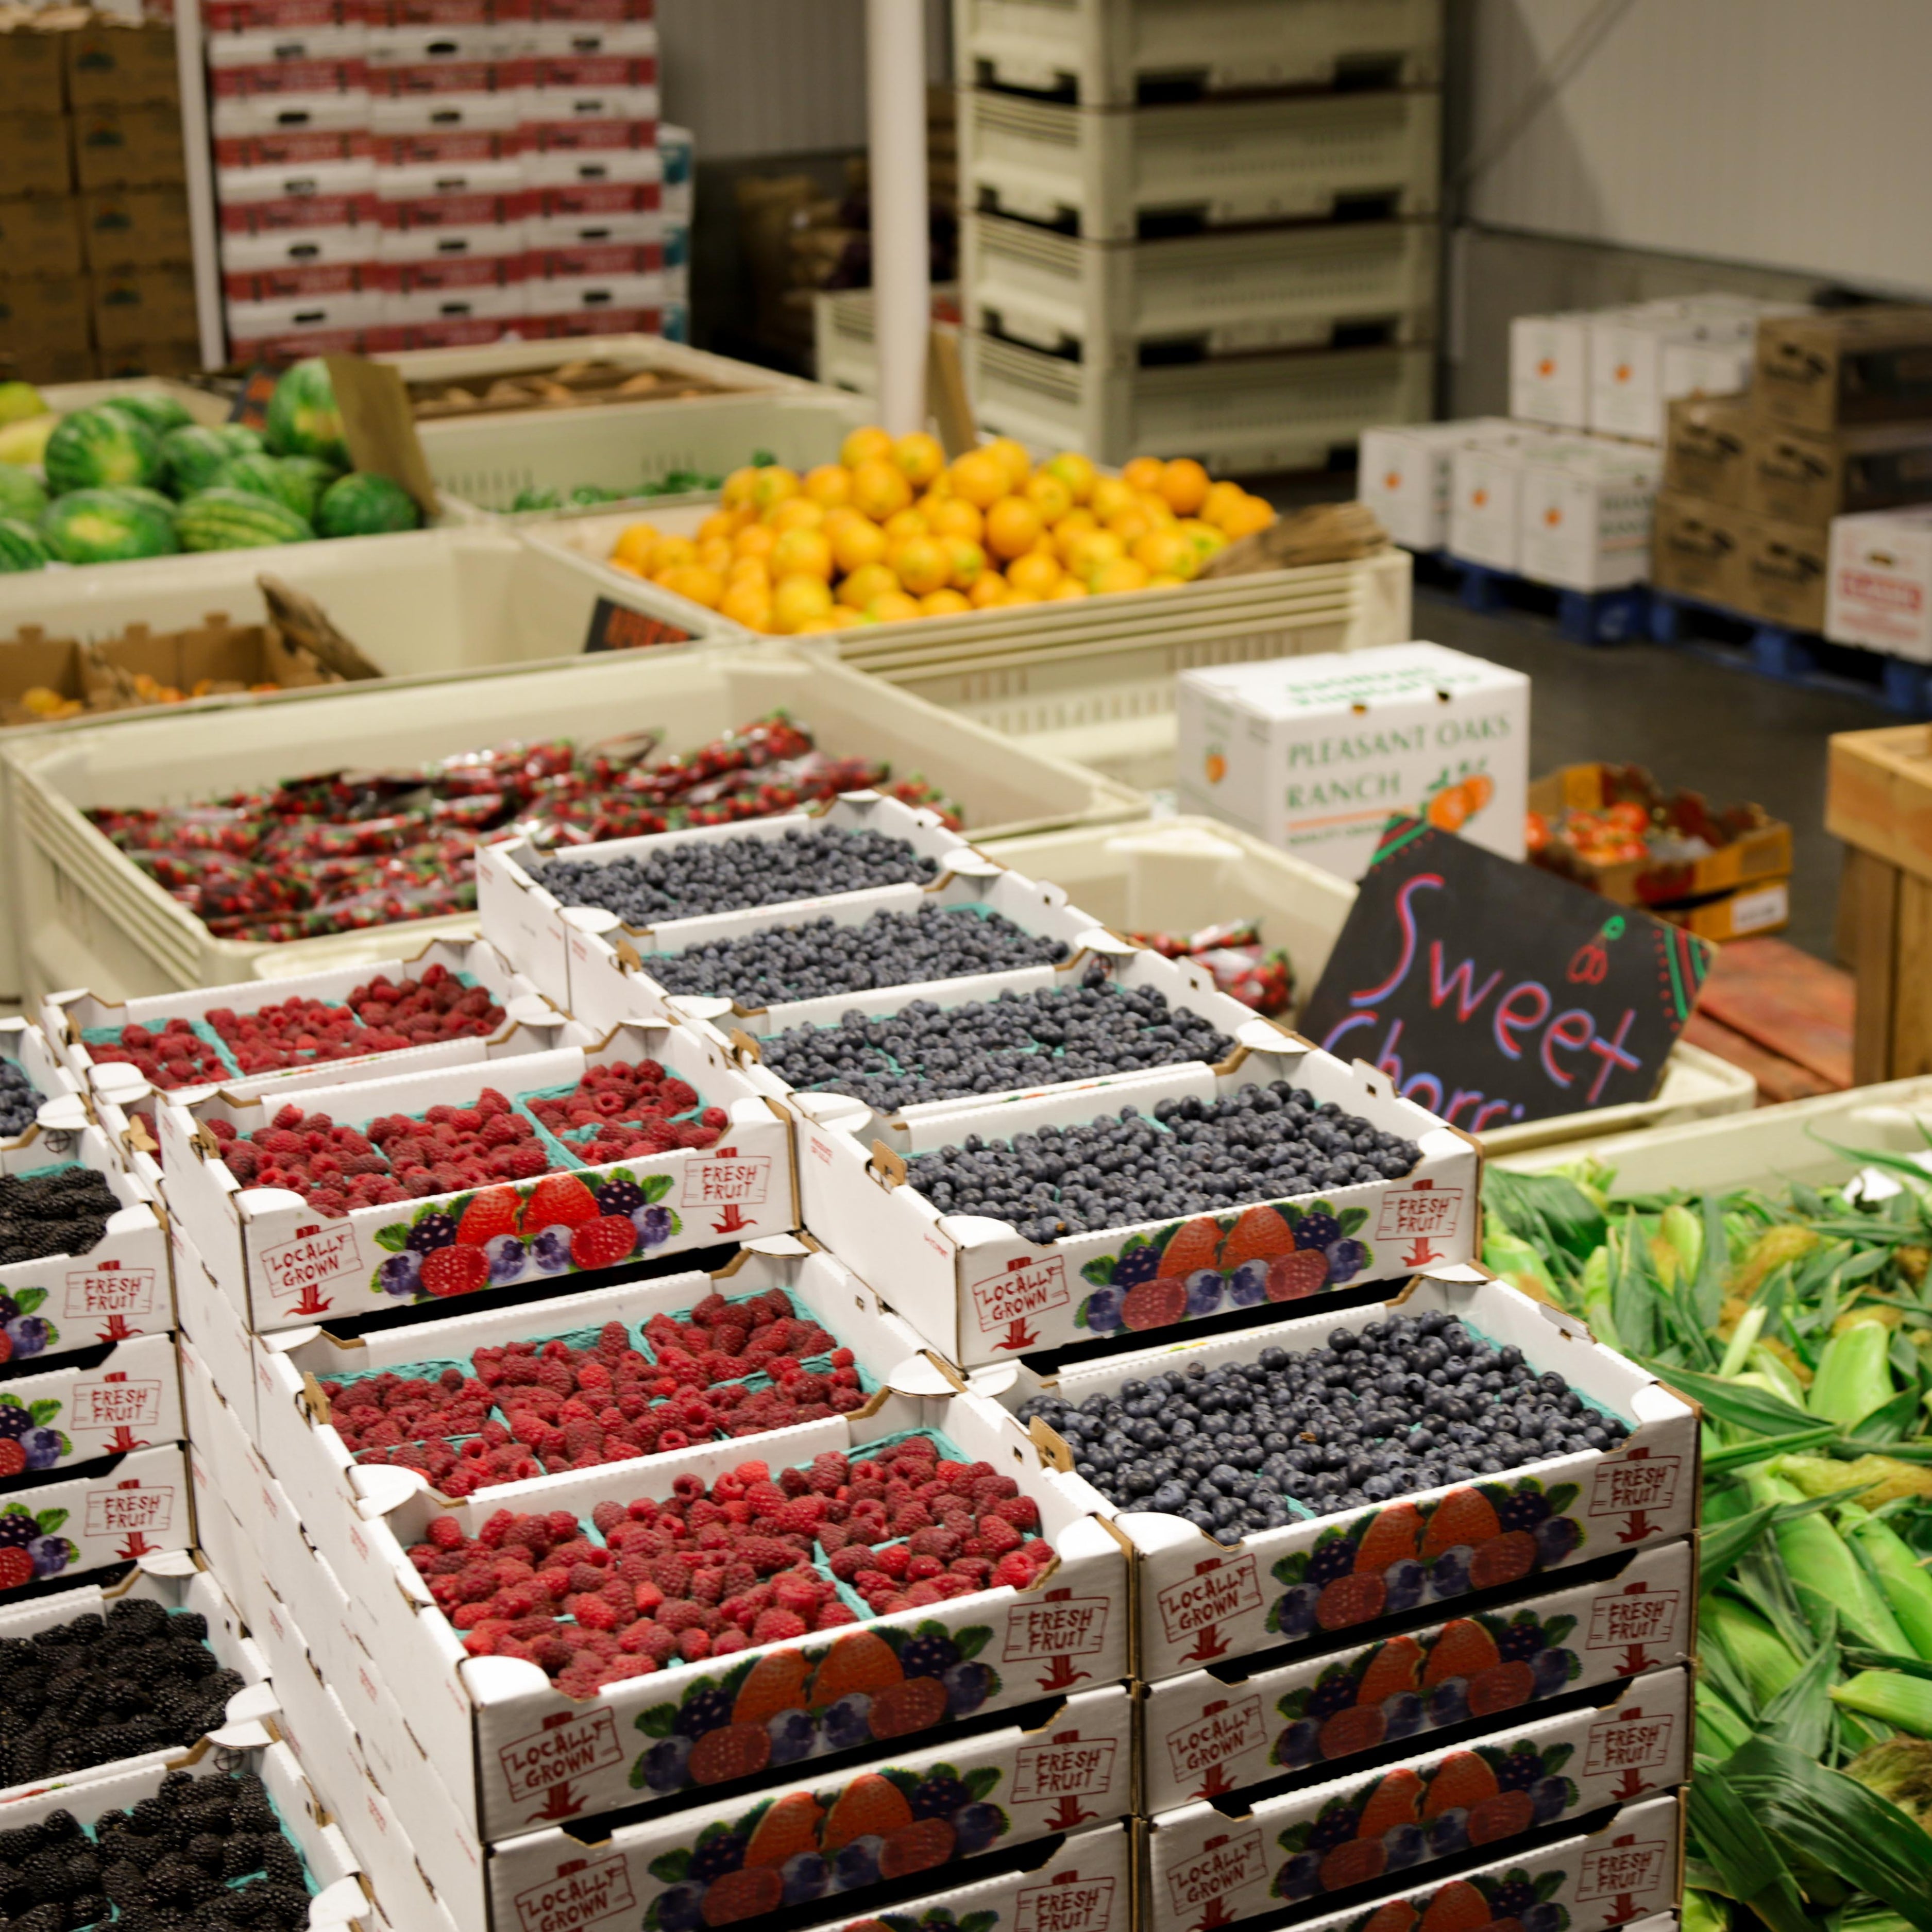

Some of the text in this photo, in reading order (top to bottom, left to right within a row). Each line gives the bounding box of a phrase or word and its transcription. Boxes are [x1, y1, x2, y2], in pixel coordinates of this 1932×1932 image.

[1287, 724, 1427, 767] PLEASANT
[1435, 718, 1511, 747] OAKS
[1286, 772, 1401, 808] RANCH
[1349, 873, 1641, 1105] Sweet
[703, 1165, 757, 1183] FRESH
[703, 1181, 752, 1200] FRUIT
[1398, 1197, 1449, 1216] FRESH
[1397, 1214, 1444, 1233] FRUIT
[271, 1234, 344, 1272] LOCALLY
[282, 1255, 338, 1286] GROWN
[84, 1277, 141, 1295] FRESH
[982, 1267, 1054, 1304] LOCALLY
[86, 1292, 136, 1311] FRUIT
[992, 1288, 1046, 1320] GROWN
[91, 1389, 147, 1407] FRESH
[93, 1404, 143, 1423] FRUIT
[1612, 1467, 1667, 1487] FRESH
[105, 1495, 160, 1514] FRESH
[1611, 1485, 1660, 1507] FRUIT
[107, 1510, 156, 1528] FRUIT
[1168, 1567, 1245, 1615] LOCALLY
[1028, 1607, 1093, 1632] FRESH
[1180, 1590, 1239, 1630] GROWN
[1609, 1600, 1665, 1621] FRESH
[1029, 1628, 1087, 1653] FRUIT
[1608, 1618, 1660, 1641] FRUIT
[1177, 1707, 1252, 1754] LOCALLY
[1606, 1725, 1660, 1747] FRESH
[512, 1720, 603, 1771] LOCALLY
[1188, 1730, 1244, 1770] GROWN
[1604, 1742, 1653, 1767] FRUIT
[526, 1745, 595, 1788] GROWN
[1036, 1749, 1102, 1773] FRESH
[1036, 1769, 1095, 1794] FRUIT
[1177, 1841, 1253, 1889] LOCALLY
[1599, 1850, 1653, 1872] FRESH
[528, 1868, 613, 1918] LOCALLY
[1188, 1863, 1245, 1902] GROWN
[1598, 1869, 1646, 1892] FRUIT
[541, 1891, 607, 1932] GROWN
[1036, 1888, 1100, 1912] FRESH
[1036, 1908, 1094, 1932] FRUIT
